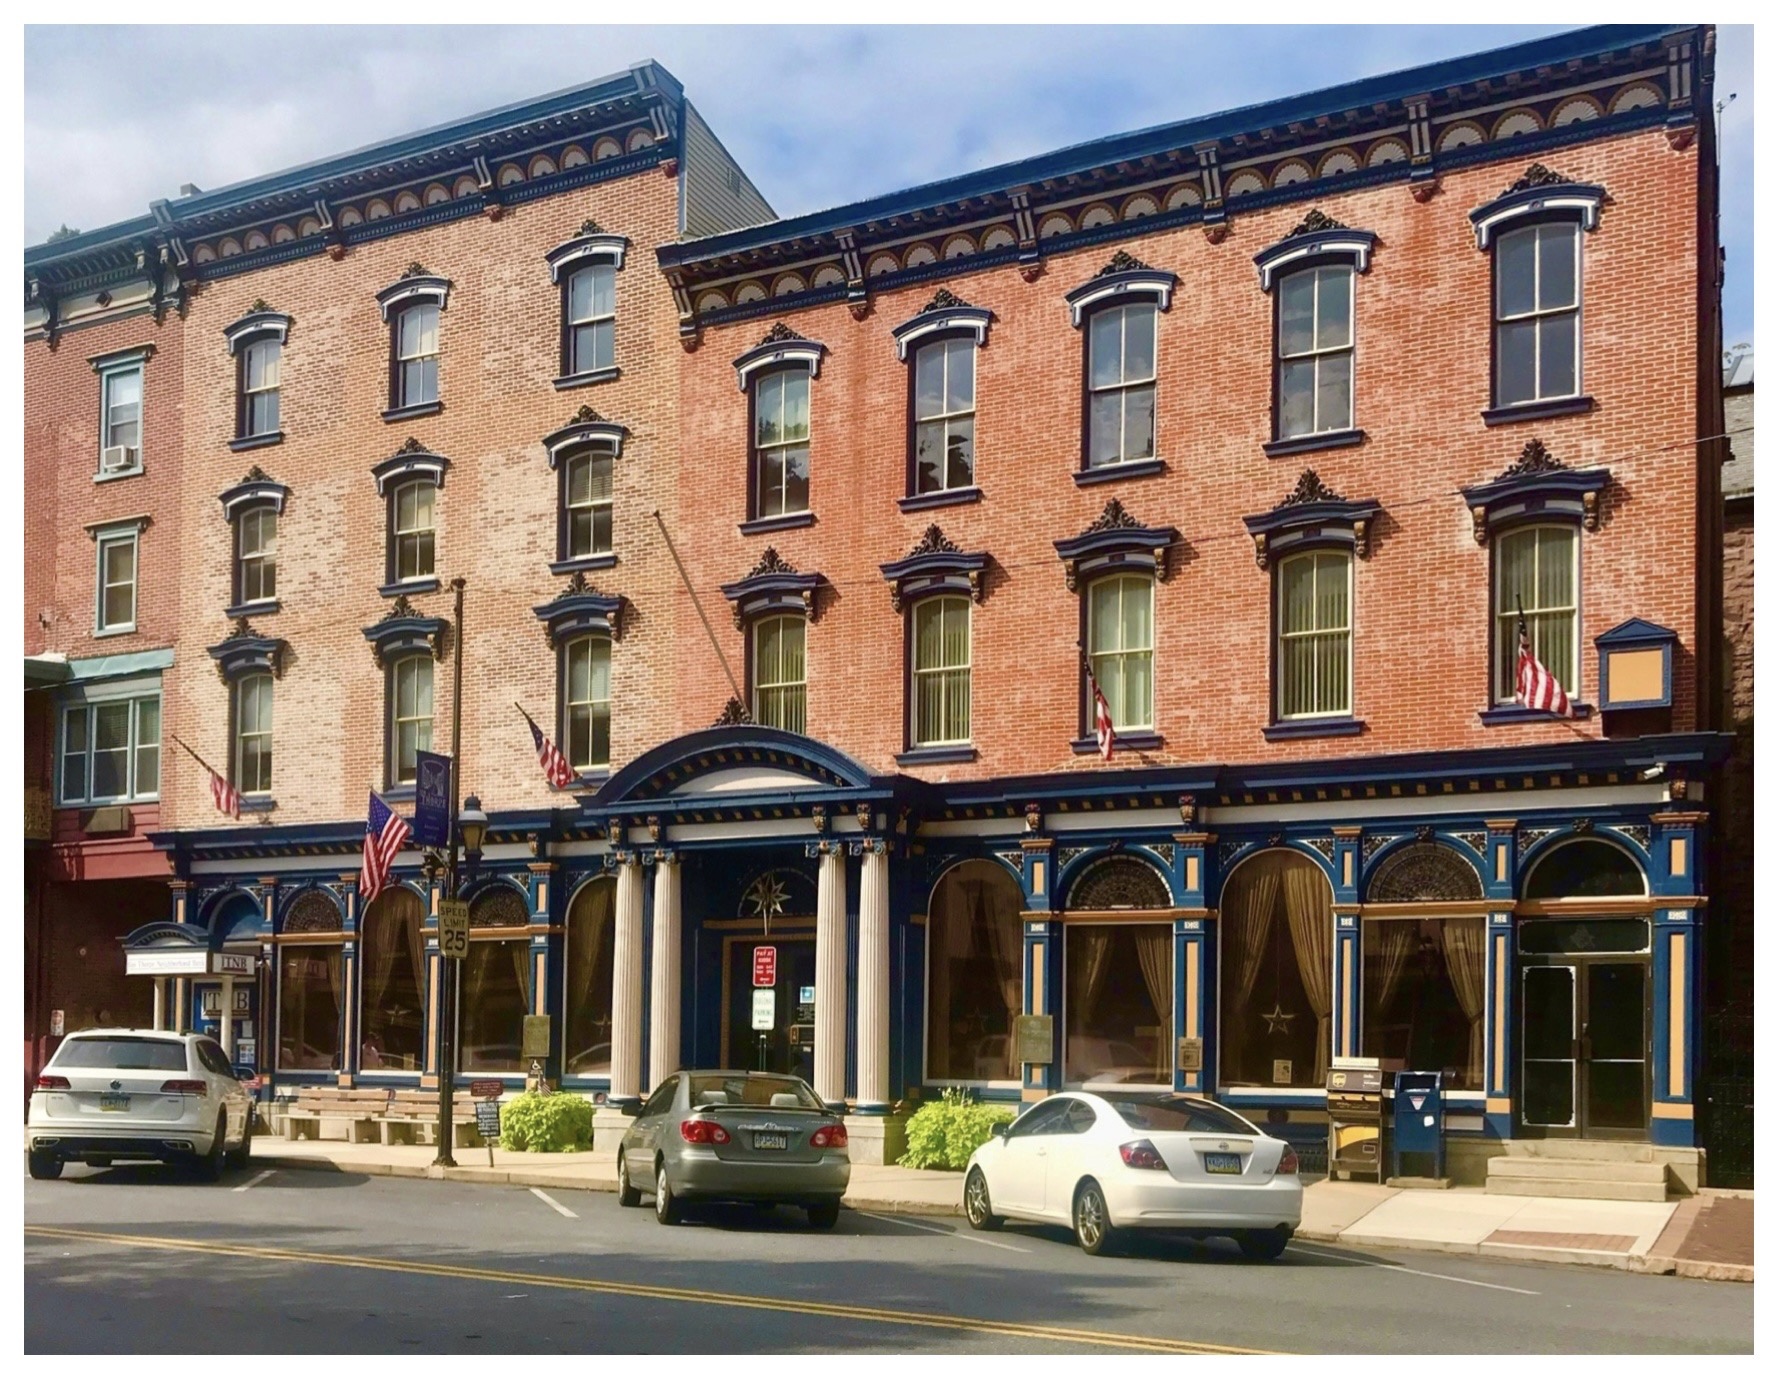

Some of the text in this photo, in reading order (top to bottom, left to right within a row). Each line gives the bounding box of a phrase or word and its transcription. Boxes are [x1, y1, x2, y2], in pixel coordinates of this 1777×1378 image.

[440, 907, 467, 917] SPEED
[443, 918, 465, 928] LIMIT
[444, 929, 466, 951] 25
